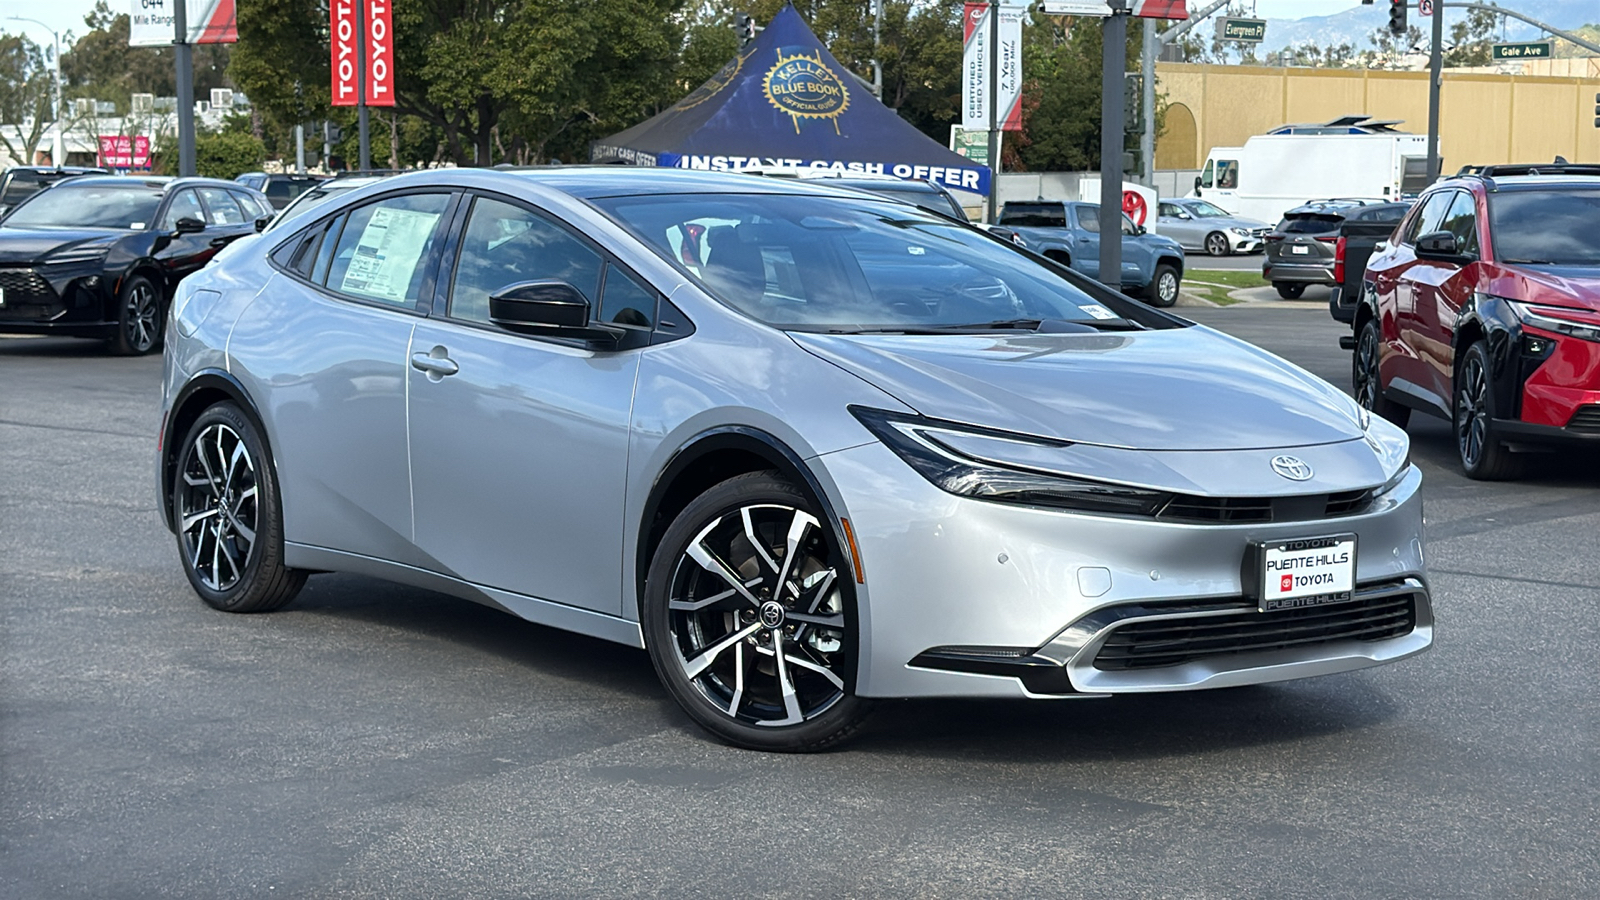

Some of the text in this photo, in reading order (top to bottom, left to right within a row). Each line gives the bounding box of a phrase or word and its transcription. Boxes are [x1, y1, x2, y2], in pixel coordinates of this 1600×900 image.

[133, 15, 149, 25] Mile
[1226, 23, 1256, 38] Evergreen
[338, 0, 353, 99] TOYOT
[371, 0, 387, 99] TOYOT
[1501, 46, 1542, 56] Gale Ave
[777, 62, 833, 80] KELLEY
[1001, 40, 1010, 91] 7 Year/
[772, 82, 841, 97] BLUE BOOK
[782, 96, 818, 110] OFFICIAL
[618, 147, 636, 162] CASH
[635, 151, 657, 166] OFFER
[893, 164, 979, 190] OFFER
[1287, 538, 1335, 549] TOYOTA
[1267, 552, 1349, 571] PUENTE HILLS
[1295, 573, 1334, 587] TOYOTA
[1268, 592, 1350, 610] PUENTE HILLS
